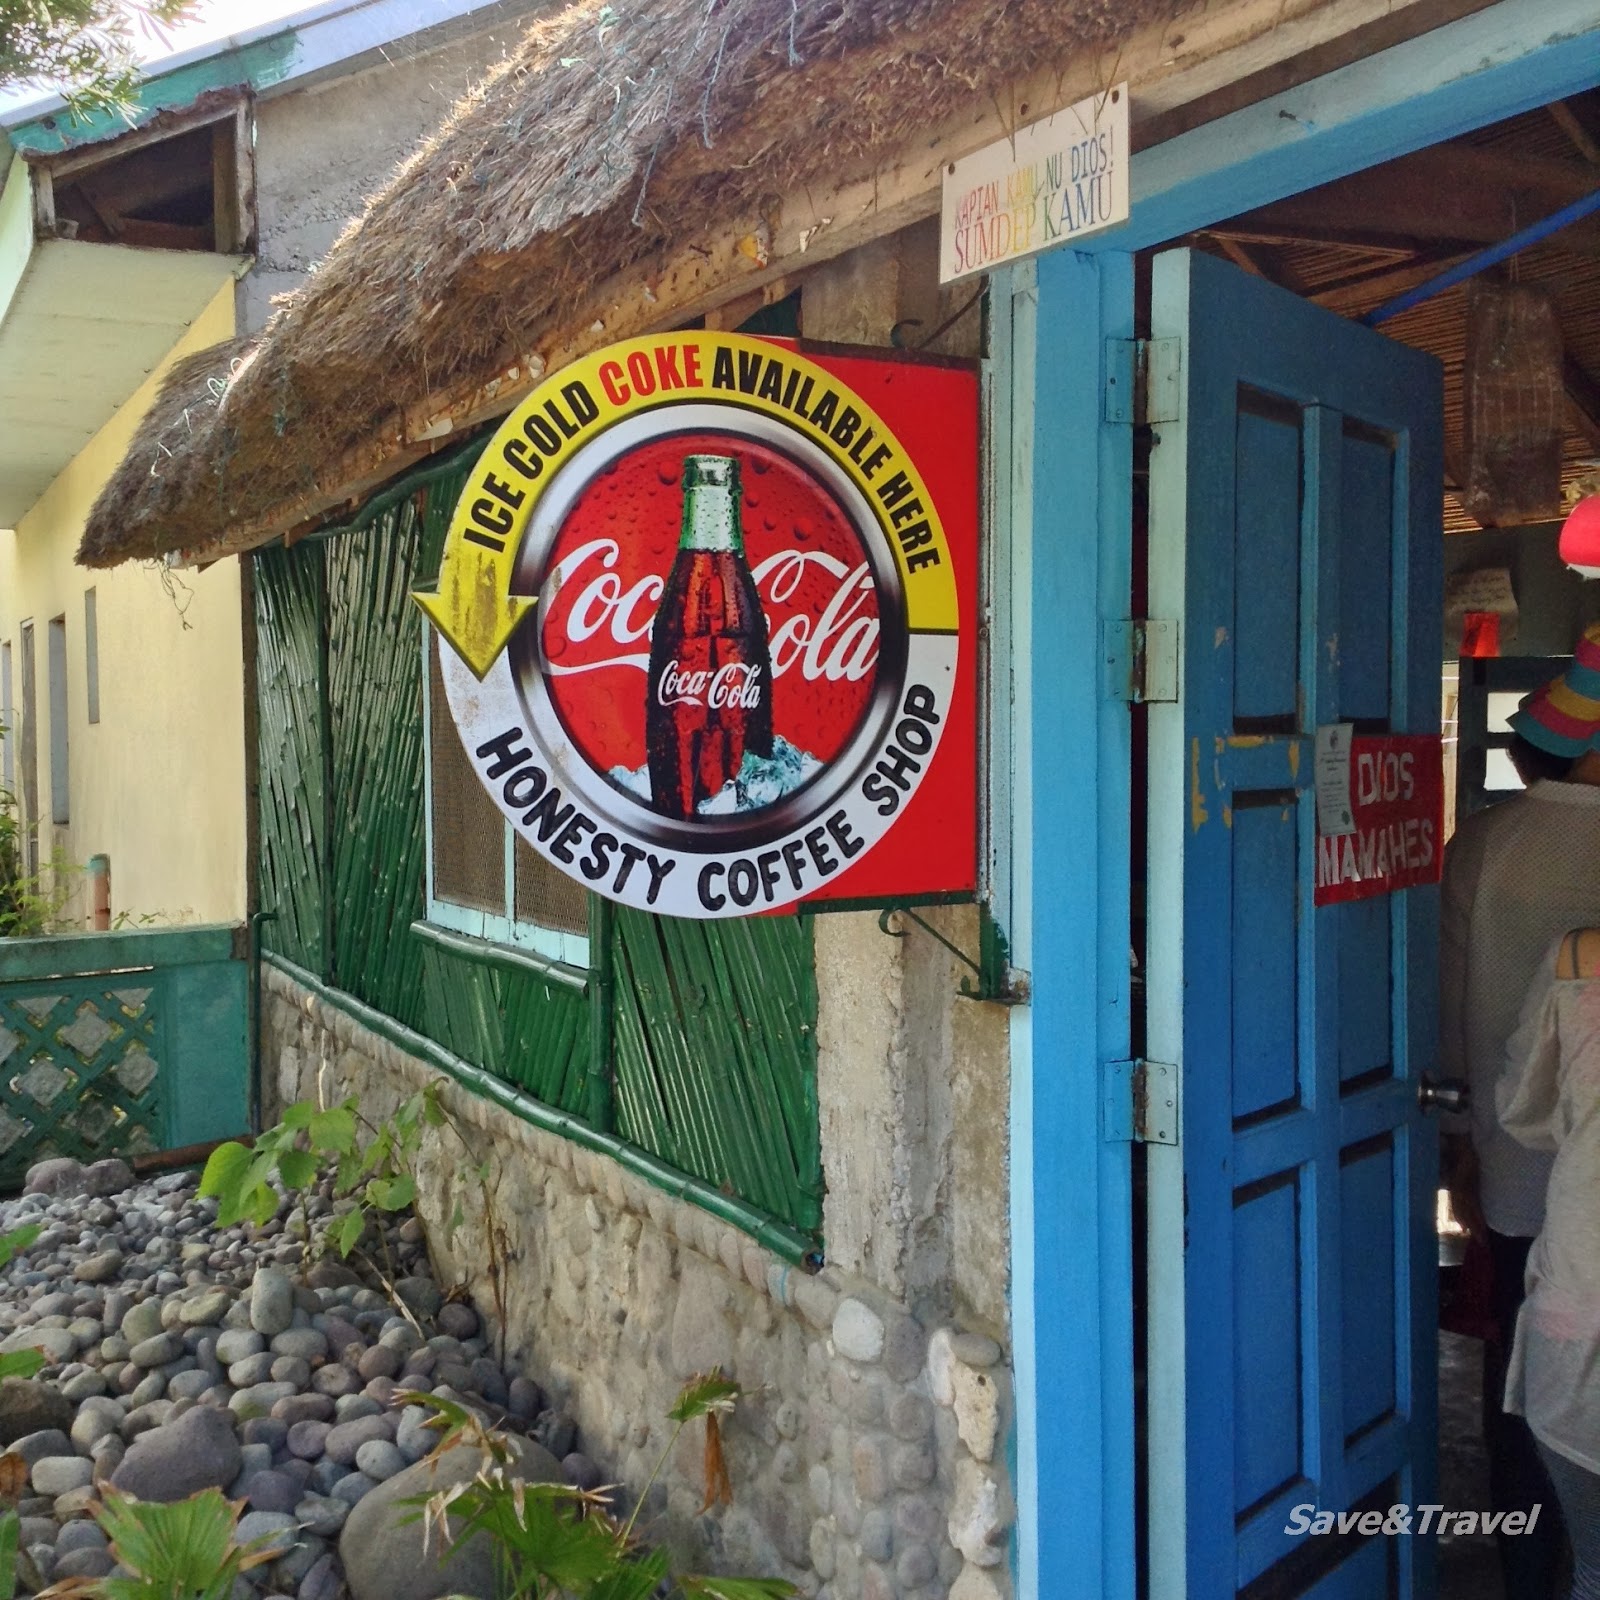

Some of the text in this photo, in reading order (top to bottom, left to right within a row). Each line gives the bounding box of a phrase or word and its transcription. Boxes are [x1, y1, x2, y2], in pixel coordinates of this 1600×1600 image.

[1046, 152, 1063, 190] NU
[1071, 125, 1114, 182] DIOS!
[1043, 171, 1113, 241] KAMU
[462, 344, 942, 576] ICE COLD COKE AVAILABLE HERE
[657, 660, 762, 710] Coca-Cola
[475, 683, 941, 911] HONESTY COFFEE SHOP
[1358, 751, 1414, 806] DIOS
